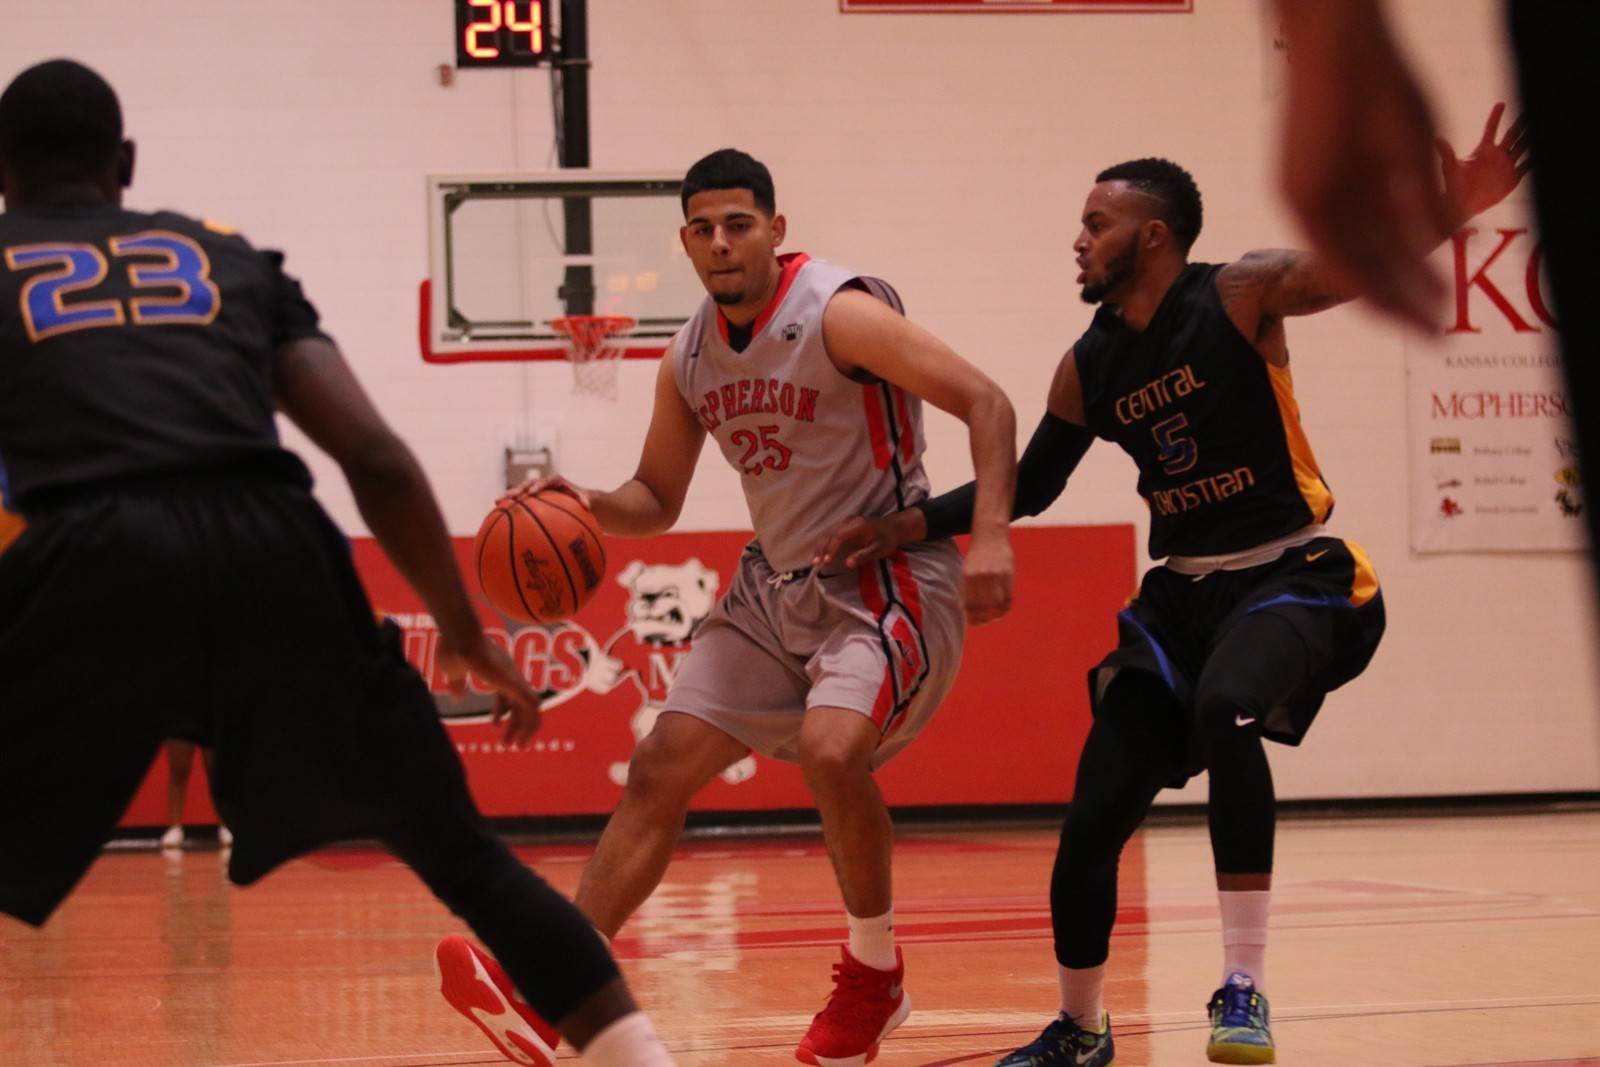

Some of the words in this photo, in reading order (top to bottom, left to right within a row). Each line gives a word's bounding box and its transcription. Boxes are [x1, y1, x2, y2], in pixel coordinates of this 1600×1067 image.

[465, 0, 542, 58] 24
[5, 229, 221, 343] 23
[696, 378, 820, 433] CPHERSON
[730, 424, 793, 476] 25
[1151, 412, 1198, 475] 5
